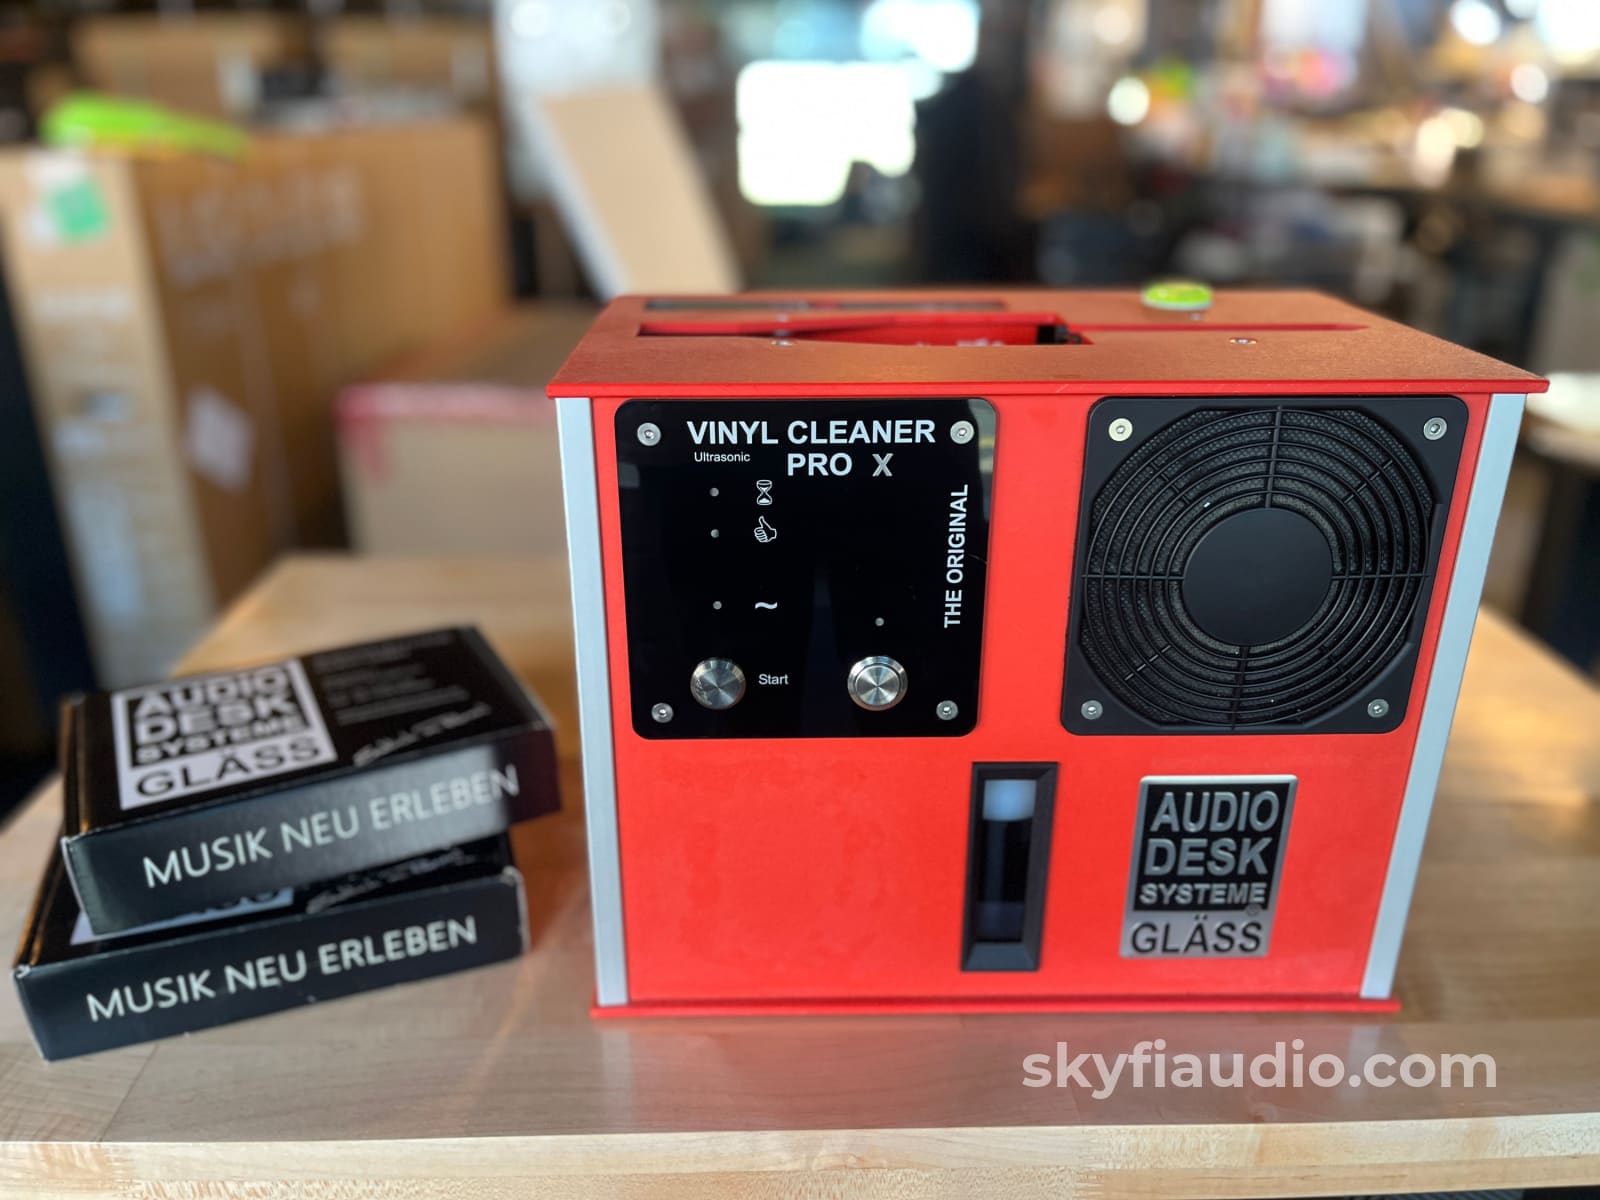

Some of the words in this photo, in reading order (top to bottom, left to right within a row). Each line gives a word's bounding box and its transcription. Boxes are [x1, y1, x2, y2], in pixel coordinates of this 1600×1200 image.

[686, 420, 779, 445] VINYL
[787, 419, 936, 445] CLEANER
[693, 451, 751, 464] Ultrasonic
[786, 452, 853, 477] PRO
[871, 453, 894, 477] X
[946, 484, 968, 584] ORIGINAL
[943, 589, 963, 629] THE
[134, 666, 289, 717] AUDIO
[758, 673, 789, 686] Start
[136, 695, 297, 745] DESK
[136, 735, 320, 797] GLÄSS
[142, 832, 272, 888] MUSIK
[281, 807, 360, 850] NEU
[372, 764, 520, 824] ERLEBEN
[1150, 790, 1280, 833] AUDIO
[1143, 837, 1273, 876] DESK
[1139, 882, 1268, 905] SYSTEME
[1131, 914, 1263, 954] GLÄSS
[86, 967, 214, 1023] MUSIK
[224, 952, 307, 994] NEU
[319, 915, 478, 975] ERLEBEN
